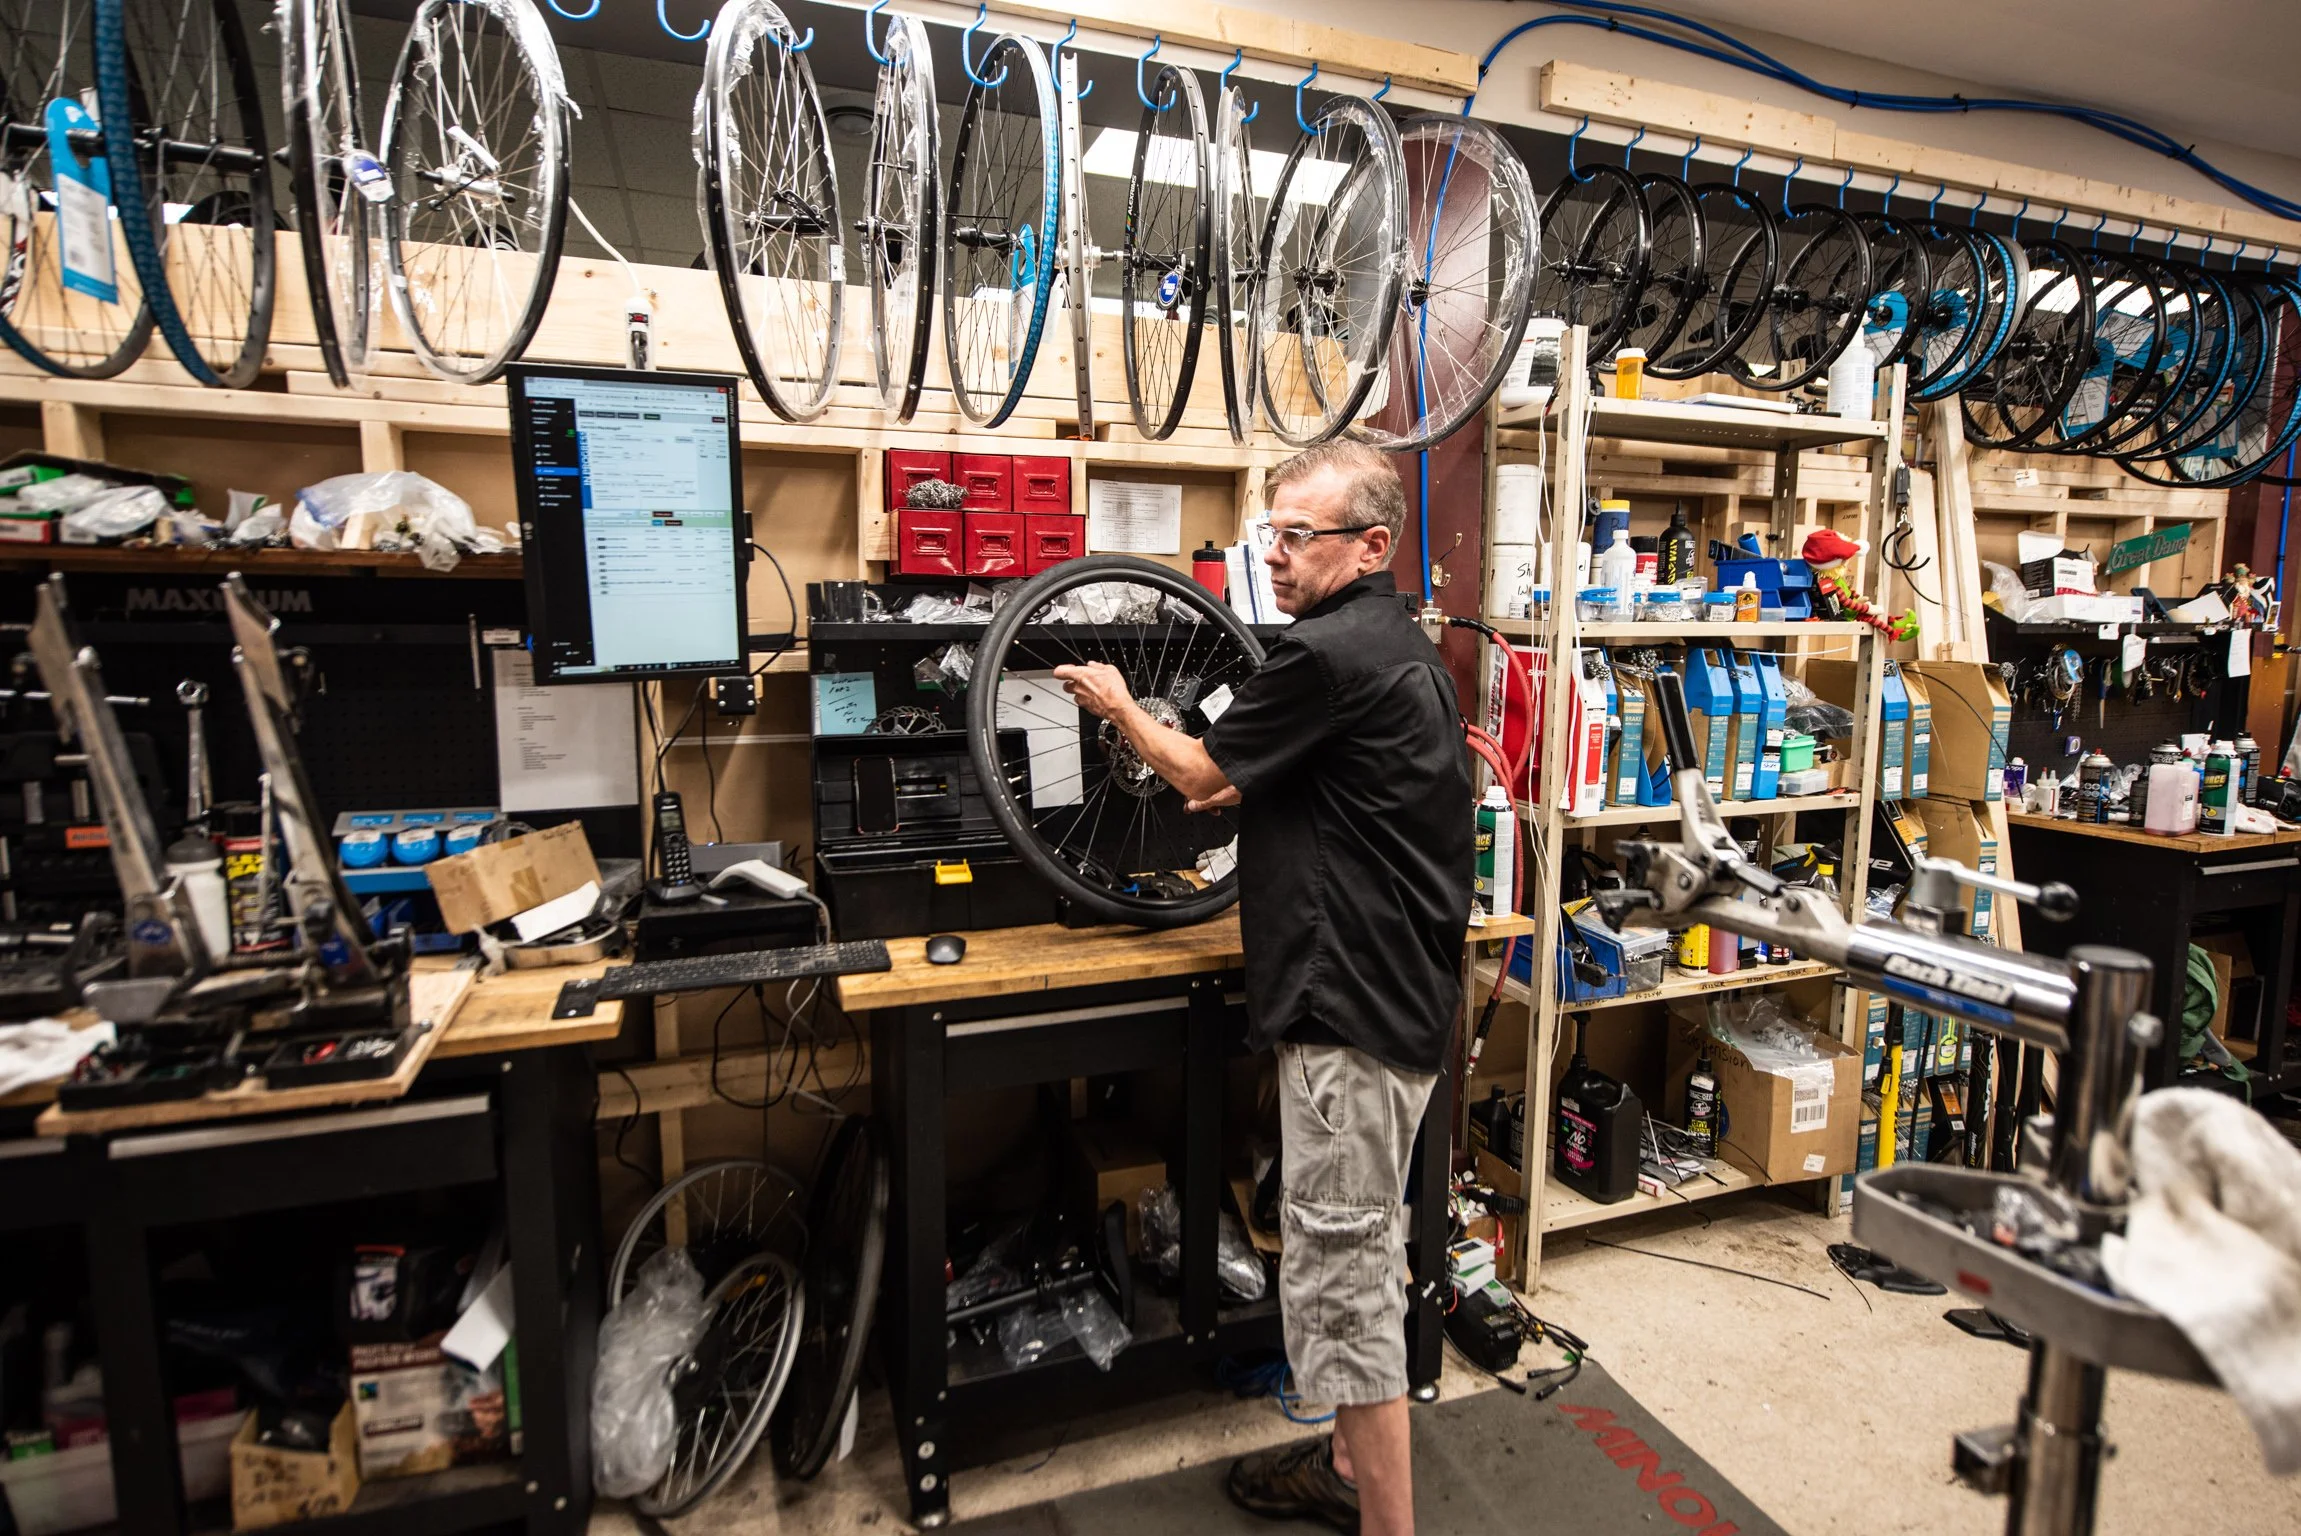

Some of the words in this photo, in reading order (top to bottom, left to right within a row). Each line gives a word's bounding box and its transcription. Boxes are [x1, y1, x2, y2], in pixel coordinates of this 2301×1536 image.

[1127, 174, 1137, 216] ALEXRIMS
[579, 431, 591, 475] PROGRESS
[2111, 544, 2150, 569] Great
[2153, 535, 2185, 559] Dane
[127, 588, 313, 612] MAXIUM
[1570, 1130, 1586, 1145] NO
[1557, 1403, 1741, 1536] MINO
